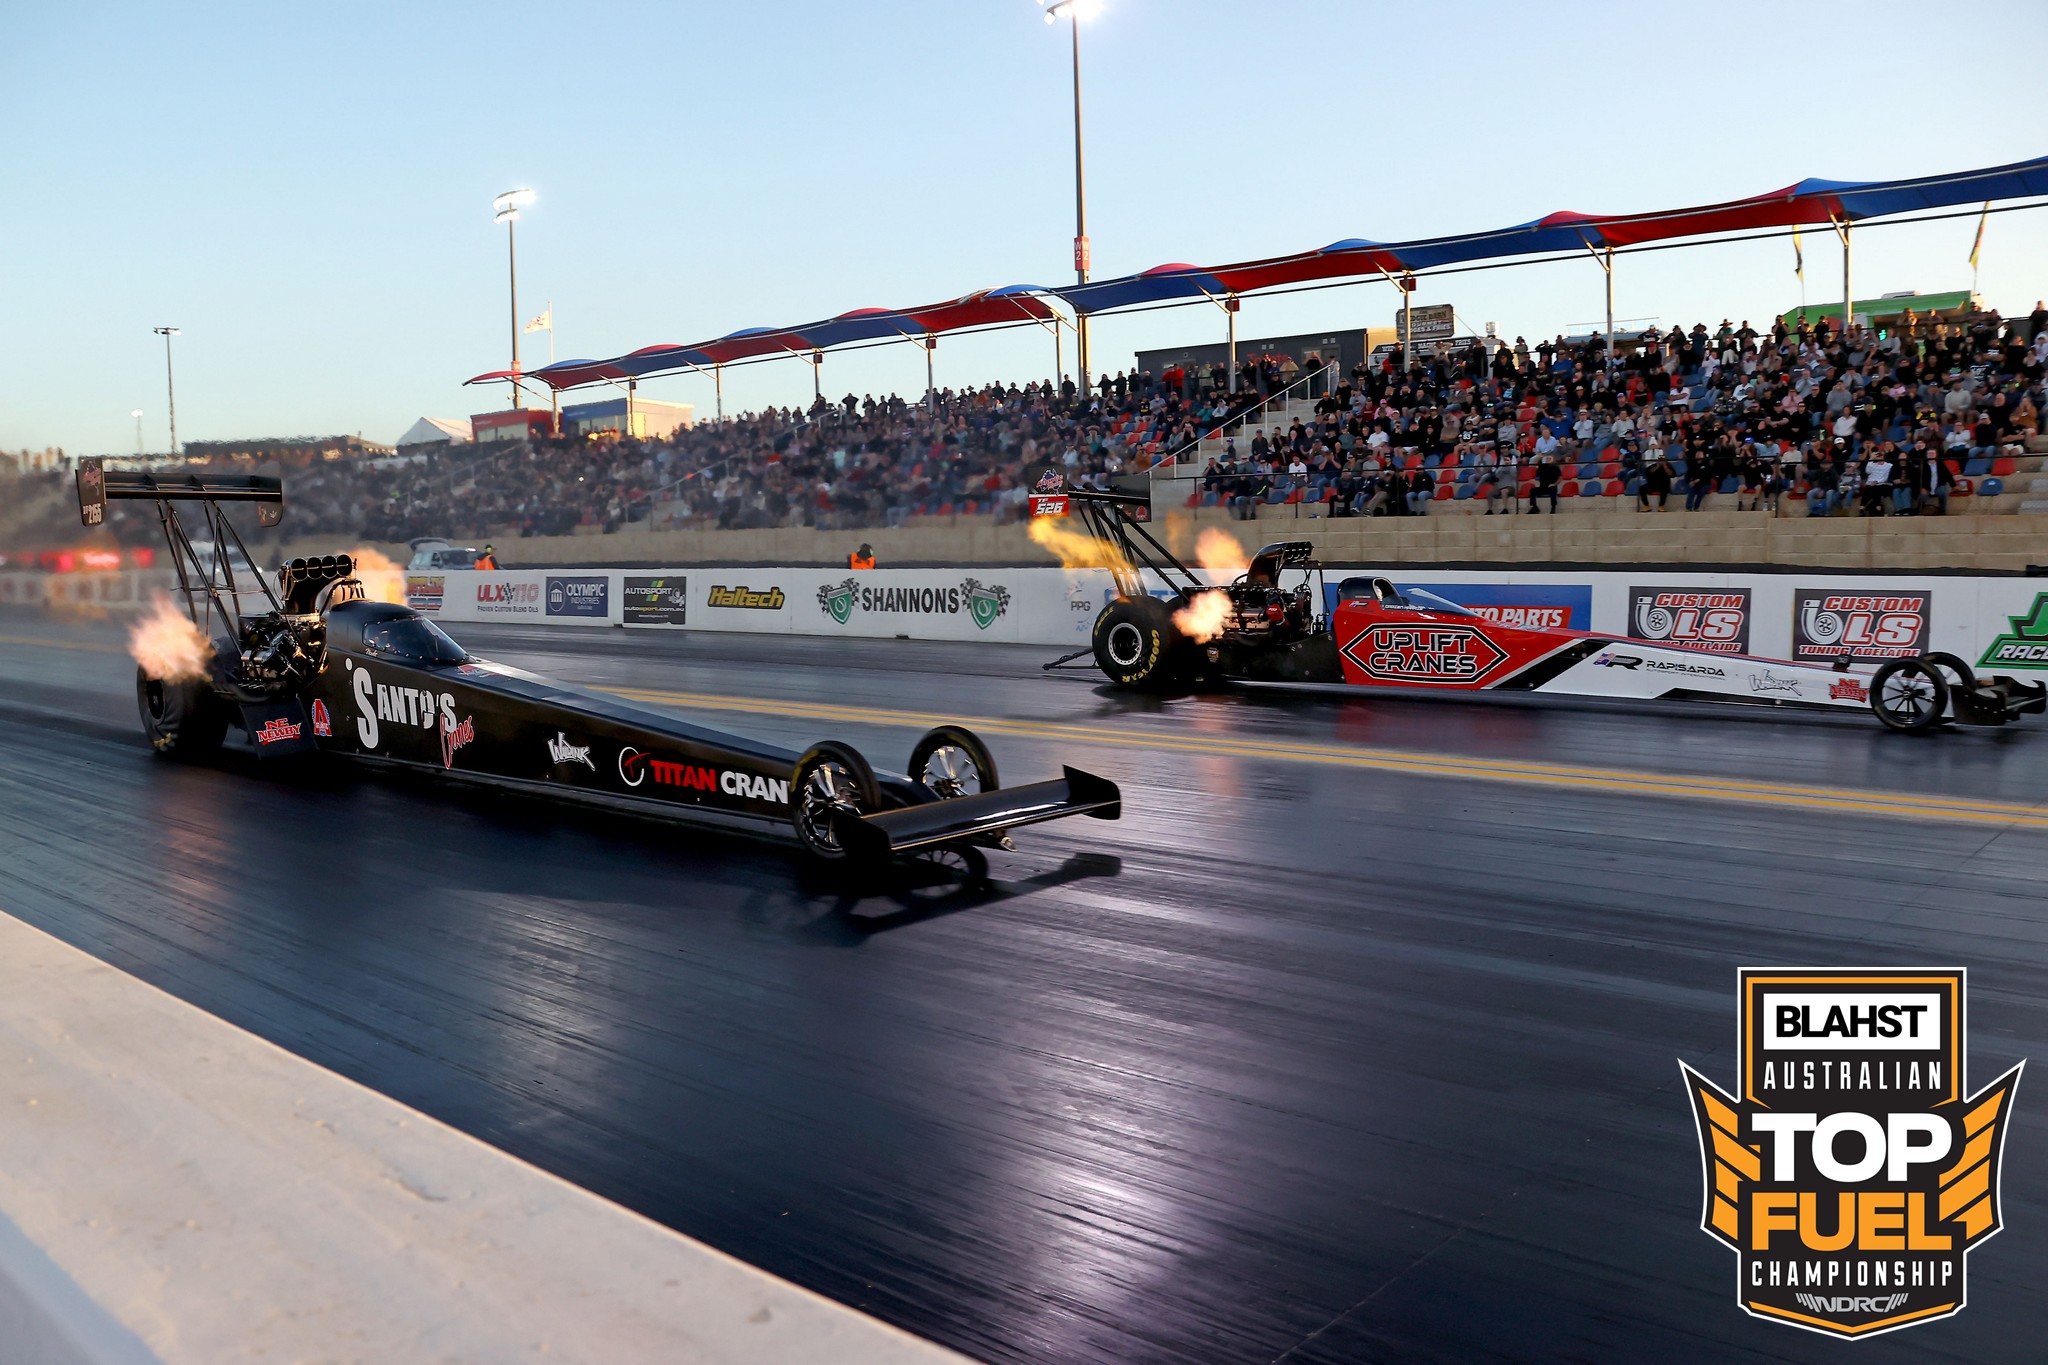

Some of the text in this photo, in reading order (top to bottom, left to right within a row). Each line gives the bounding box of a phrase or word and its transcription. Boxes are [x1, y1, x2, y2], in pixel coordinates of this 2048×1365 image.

[1035, 502, 1064, 515] 526
[477, 584, 505, 603] ULX
[566, 583, 605, 597] OLYMPIC
[624, 587, 673, 595] AUTOSPORT
[708, 586, 785, 609] Haltech
[861, 587, 960, 614] SHANNONS
[1070, 600, 1091, 612] PPG
[1655, 594, 1745, 609] CUSTOM
[1822, 596, 1924, 612] CUSTOM
[1501, 608, 1564, 628] PARTS
[1670, 608, 1744, 642] LS
[1840, 611, 1923, 647] LS
[1373, 630, 1474, 654] UPLIFT
[1799, 644, 1921, 658] TUNING ADELAIDE
[1369, 651, 1478, 675] CRANES
[1646, 660, 1726, 677] RAPISARDA
[256, 723, 302, 743] NEWBY
[265, 718, 288, 731] NE
[650, 760, 791, 805] TITAN CRAN
